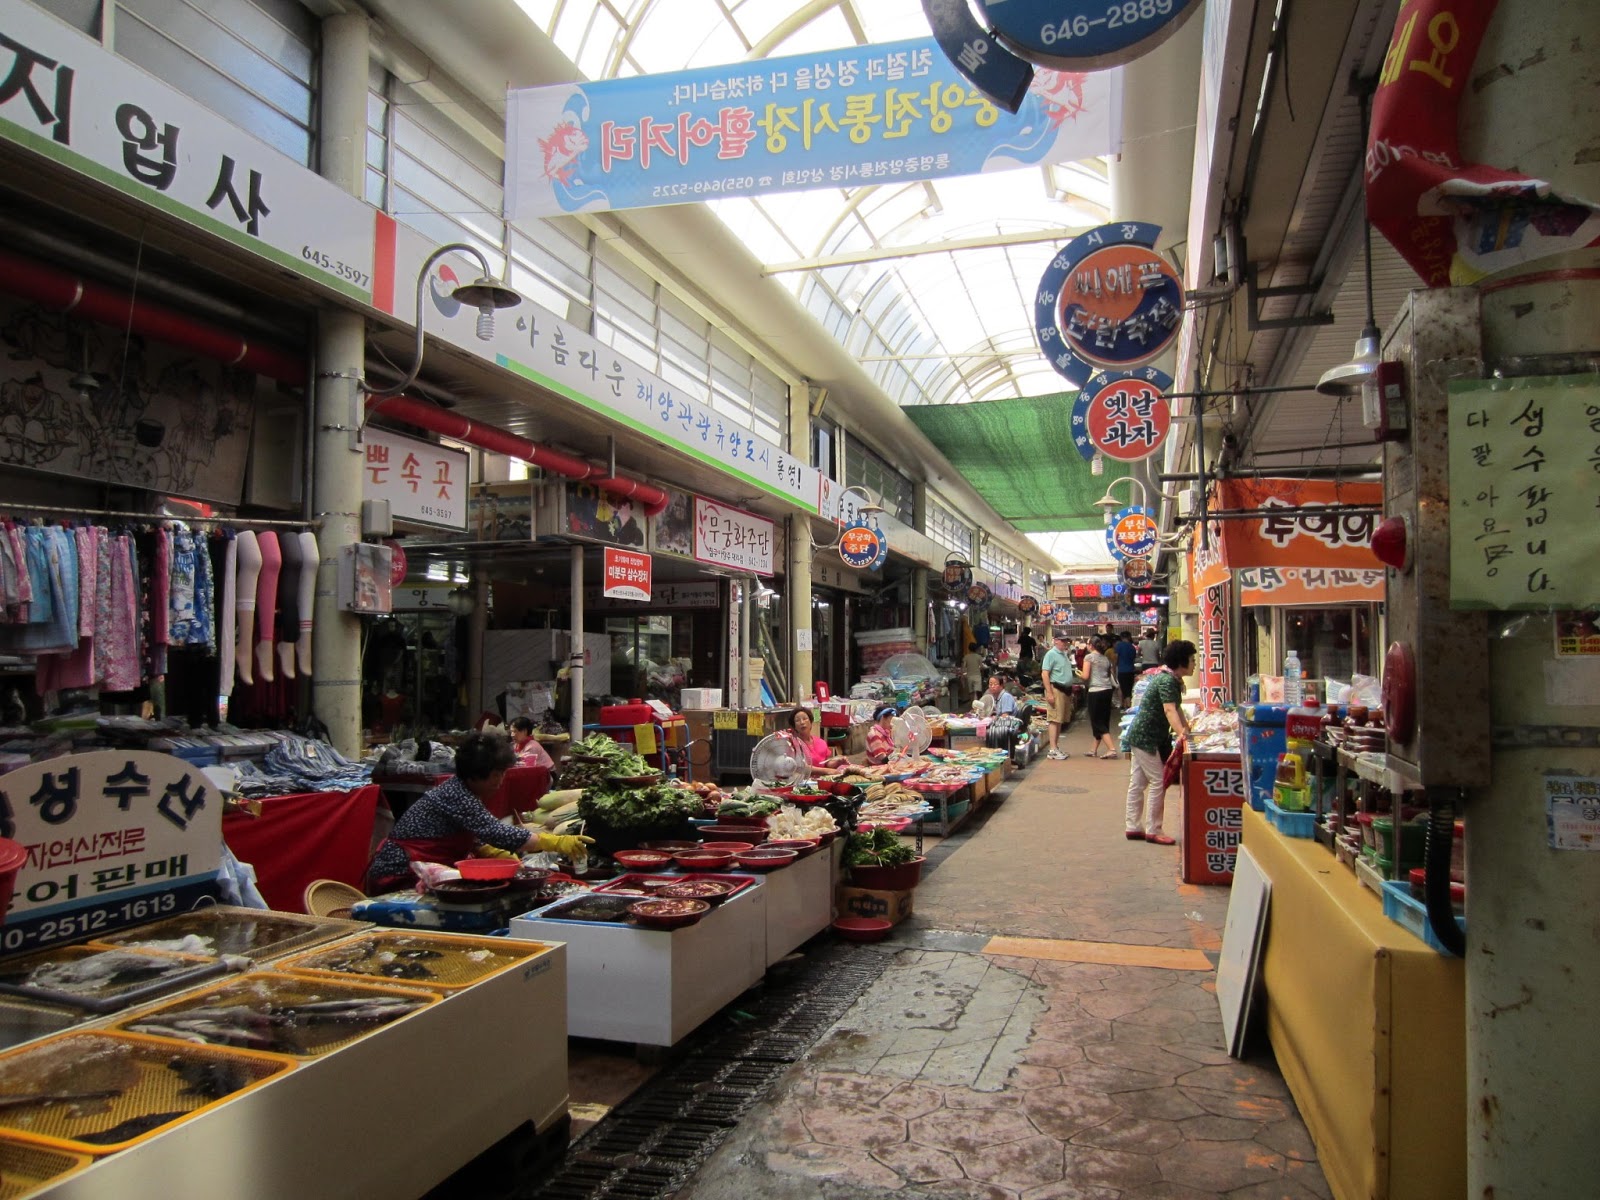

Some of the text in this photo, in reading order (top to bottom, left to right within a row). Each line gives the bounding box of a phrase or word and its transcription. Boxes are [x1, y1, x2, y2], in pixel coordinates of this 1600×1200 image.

[1040, 0, 1173, 45] 646-2889
[302, 245, 369, 287] 645-3597
[1074, 261, 1168, 297] 씨에프
[1067, 296, 1180, 349] 단란주점
[516, 316, 626, 396] 아름다운
[1105, 391, 1156, 418] 옛날
[1103, 420, 1158, 448] 과자
[421, 505, 452, 519] 645-3597
[1125, 520, 1145, 530] 부산
[709, 517, 769, 555] 무궁화주단
[849, 533, 872, 542] 무궁화
[849, 544, 869, 554] 주단
[608, 566, 648, 583] 미분무 살수장치
[843, 553, 872, 566] 642-1234
[21, 828, 146, 871] 자연산전문
[91, 855, 188, 892] 판매
[0, 894, 176, 949] 0-2512-1613
